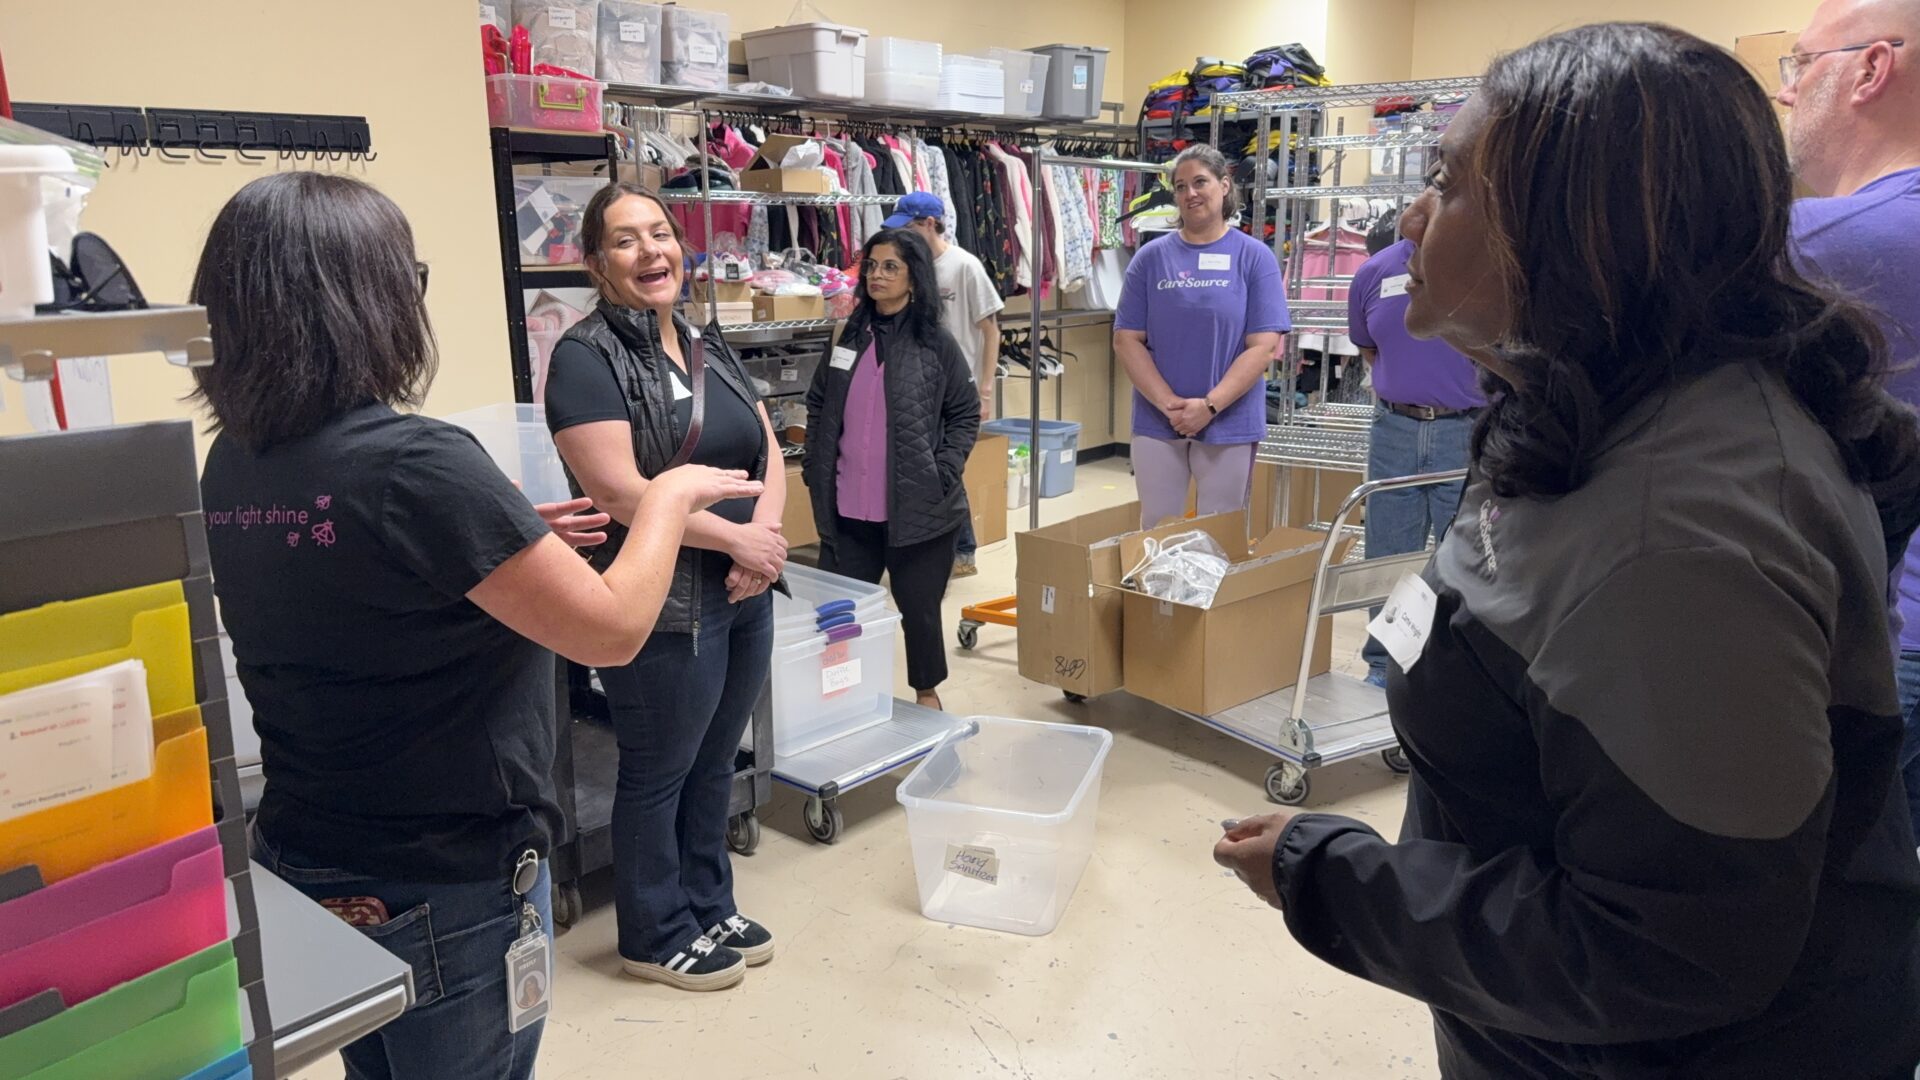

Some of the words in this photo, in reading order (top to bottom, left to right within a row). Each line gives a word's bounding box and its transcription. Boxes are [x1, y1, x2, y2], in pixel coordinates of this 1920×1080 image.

[1157, 278, 1230, 290] CareSource
[208, 510, 233, 530] your
[235, 504, 262, 530] light
[265, 503, 309, 525] shine
[1480, 499, 1497, 572] CareSource
